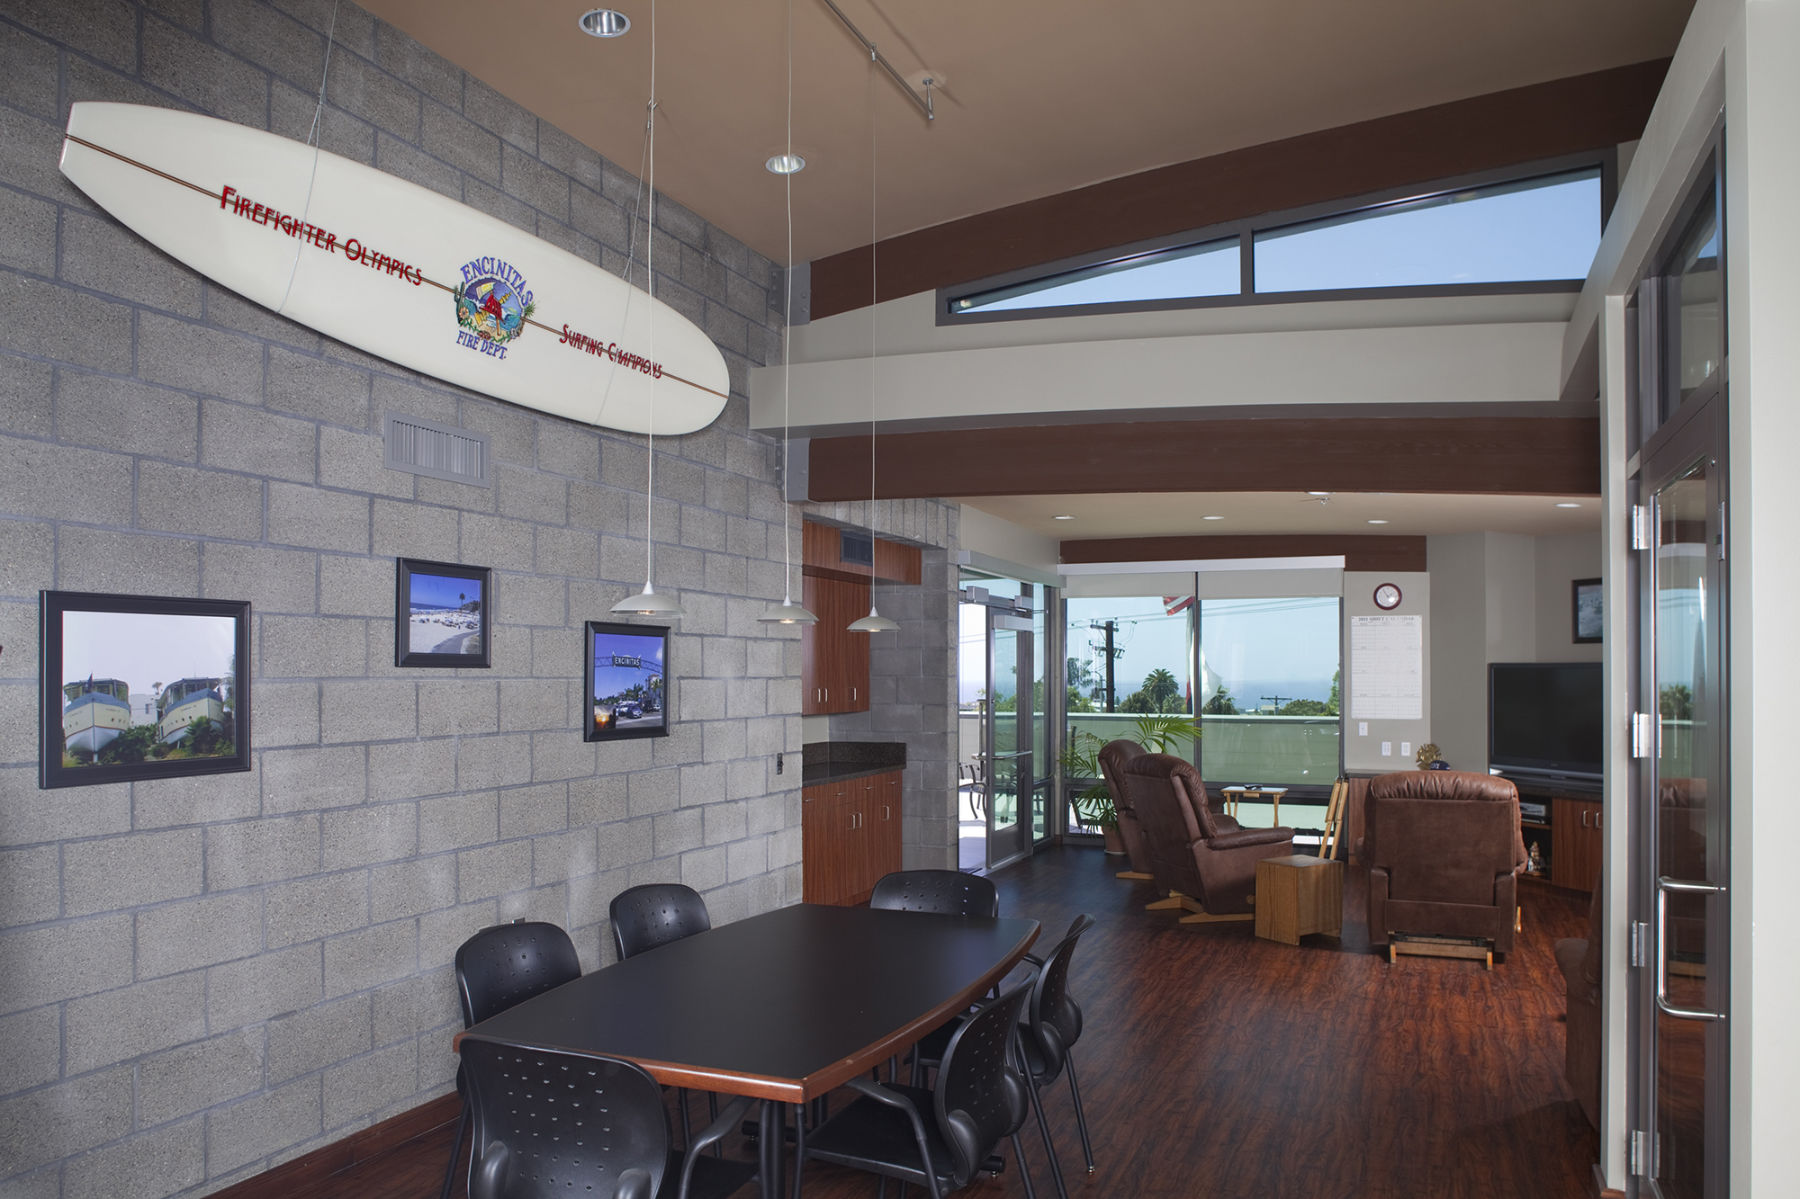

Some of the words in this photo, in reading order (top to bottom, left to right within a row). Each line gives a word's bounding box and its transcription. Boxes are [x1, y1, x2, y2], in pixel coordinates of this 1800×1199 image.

[220, 185, 336, 253] FIREFIGHTER
[344, 238, 423, 286] OLYMPICS
[460, 256, 534, 307] ENCINITAS
[456, 330, 478, 352] FIRE
[480, 339, 509, 361] DEPT.
[559, 323, 604, 358] SURFING
[608, 342, 663, 379] CHAMPIONS
